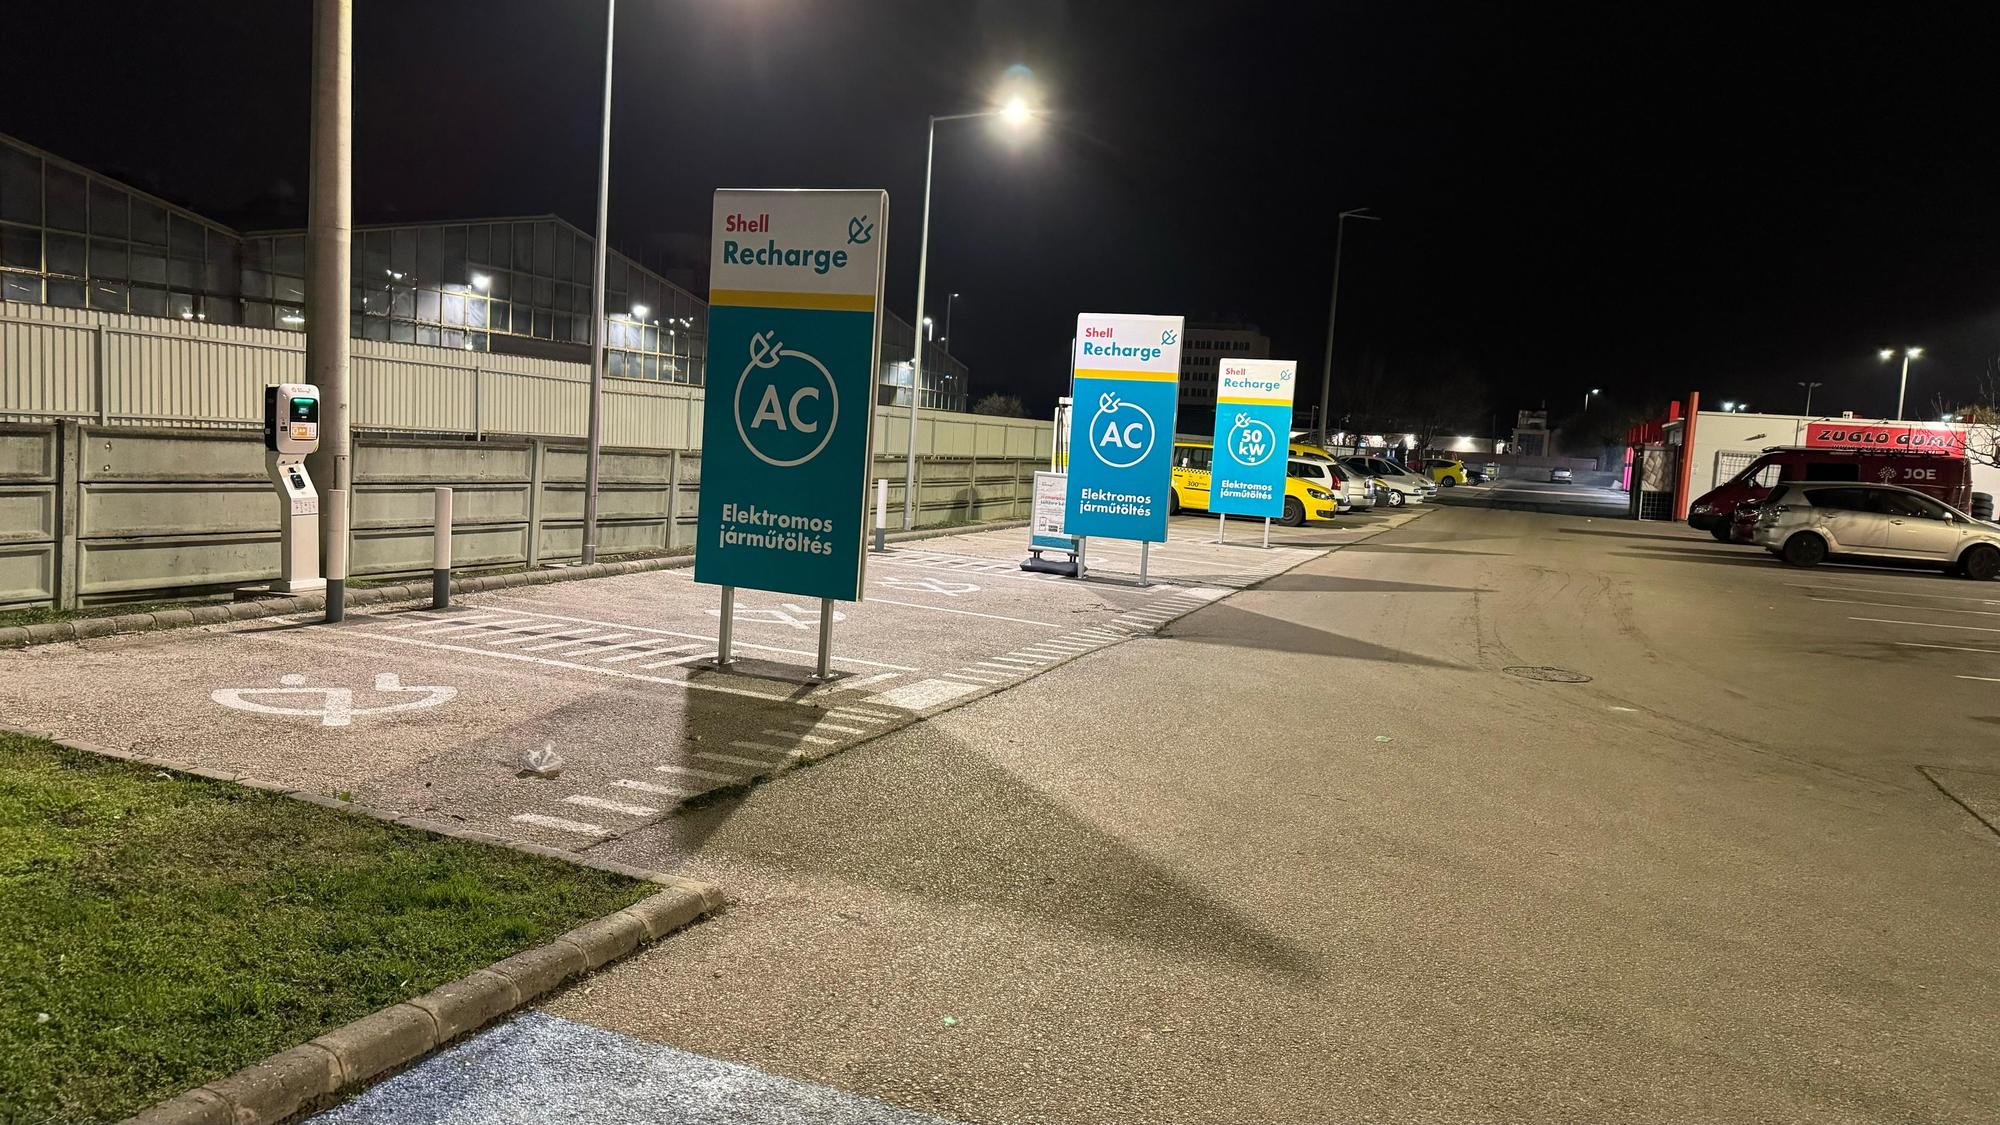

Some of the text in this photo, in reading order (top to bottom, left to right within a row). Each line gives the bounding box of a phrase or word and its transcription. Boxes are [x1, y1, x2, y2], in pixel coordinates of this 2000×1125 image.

[726, 213, 770, 233] Shell
[723, 239, 848, 275] Recharge
[1085, 327, 1113, 338] Shell
[1083, 341, 1161, 361] Recharge
[1224, 378, 1280, 392] Recharge
[750, 384, 820, 434] AC
[1099, 421, 1144, 449] AC
[1241, 429, 1263, 443] 50
[1817, 430, 1890, 444] ZUGLÓ
[1238, 442, 1266, 456] kW
[1903, 468, 1937, 480] JOE
[1221, 480, 1273, 491] Elektromos
[1081, 488, 1152, 504] Elektromos
[1220, 488, 1273, 500] járműtöltés
[1080, 500, 1152, 517] járműtöltés
[722, 503, 833, 532] Elektromos
[719, 524, 833, 555] járműtöltés
